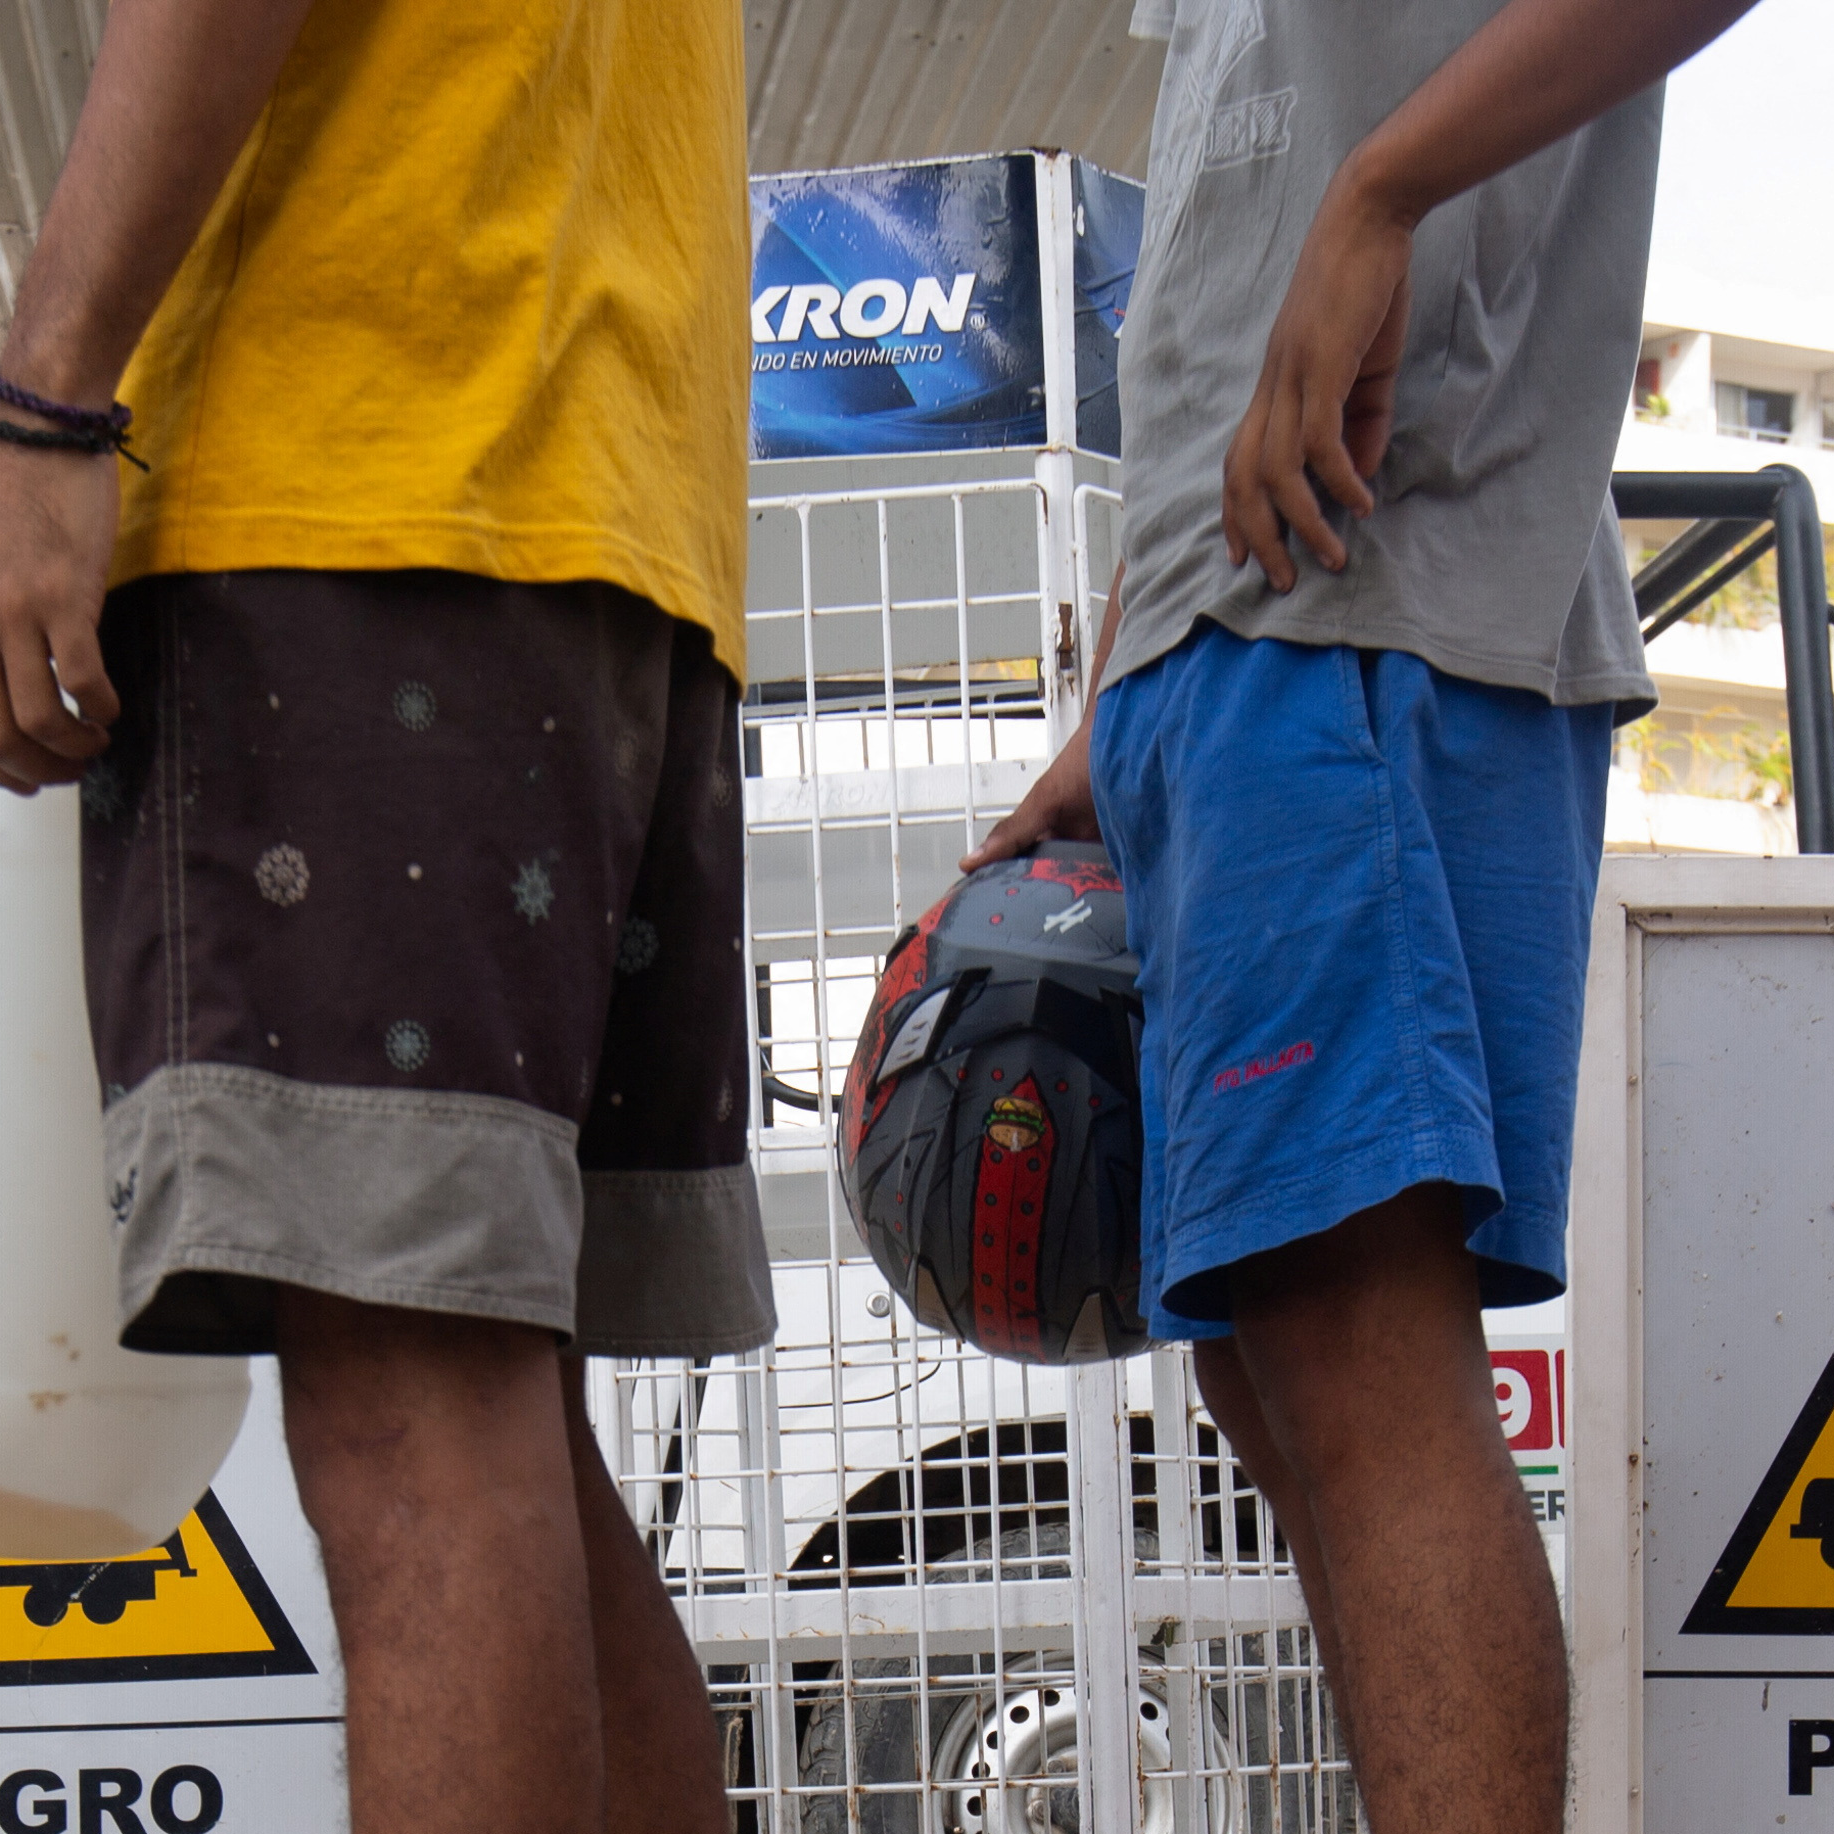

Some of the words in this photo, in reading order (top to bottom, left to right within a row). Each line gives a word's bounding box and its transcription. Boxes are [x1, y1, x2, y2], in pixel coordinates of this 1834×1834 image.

[751, 272, 977, 343] KRON
[790, 350, 818, 371] EN
[822, 343, 943, 369] MOVIMIENTO
[1529, 1490, 1565, 1522] ER
